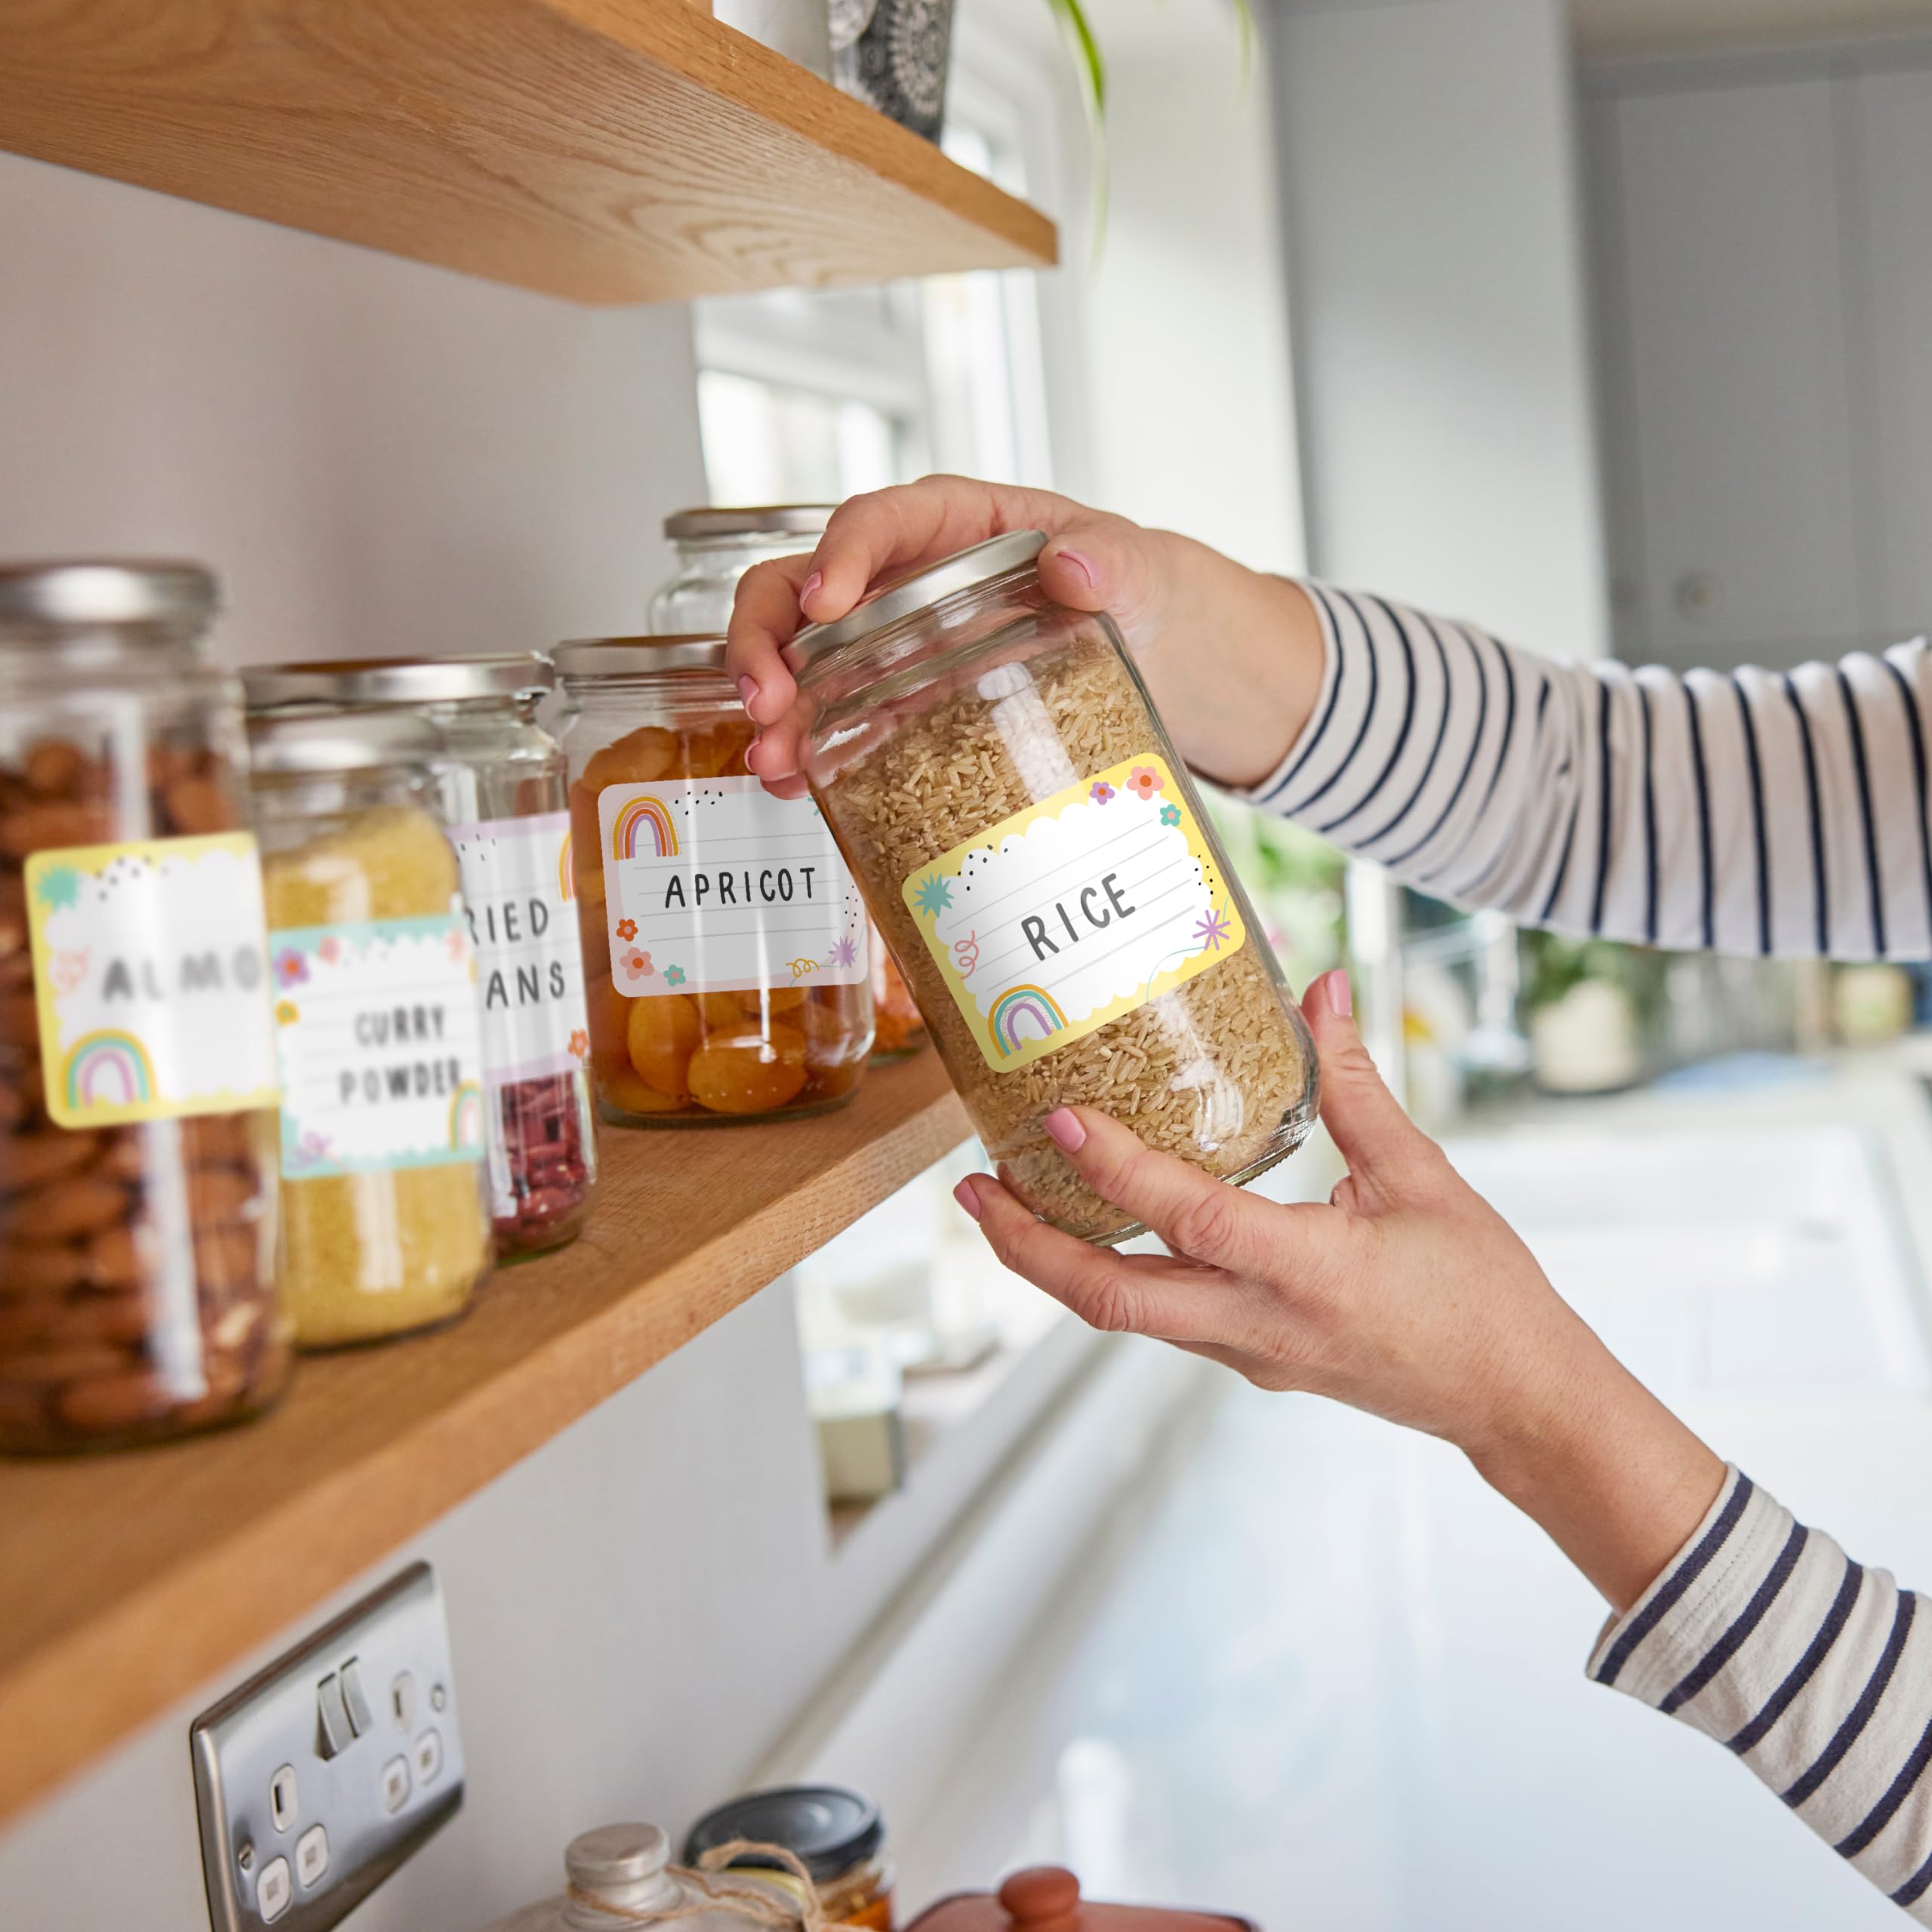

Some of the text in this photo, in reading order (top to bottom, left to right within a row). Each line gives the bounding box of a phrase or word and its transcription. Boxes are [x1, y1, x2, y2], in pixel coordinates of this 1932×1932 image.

[665, 867, 815, 909] APRICOT
[1021, 873, 1136, 961] RICE
[355, 1004, 445, 1046] CURRY
